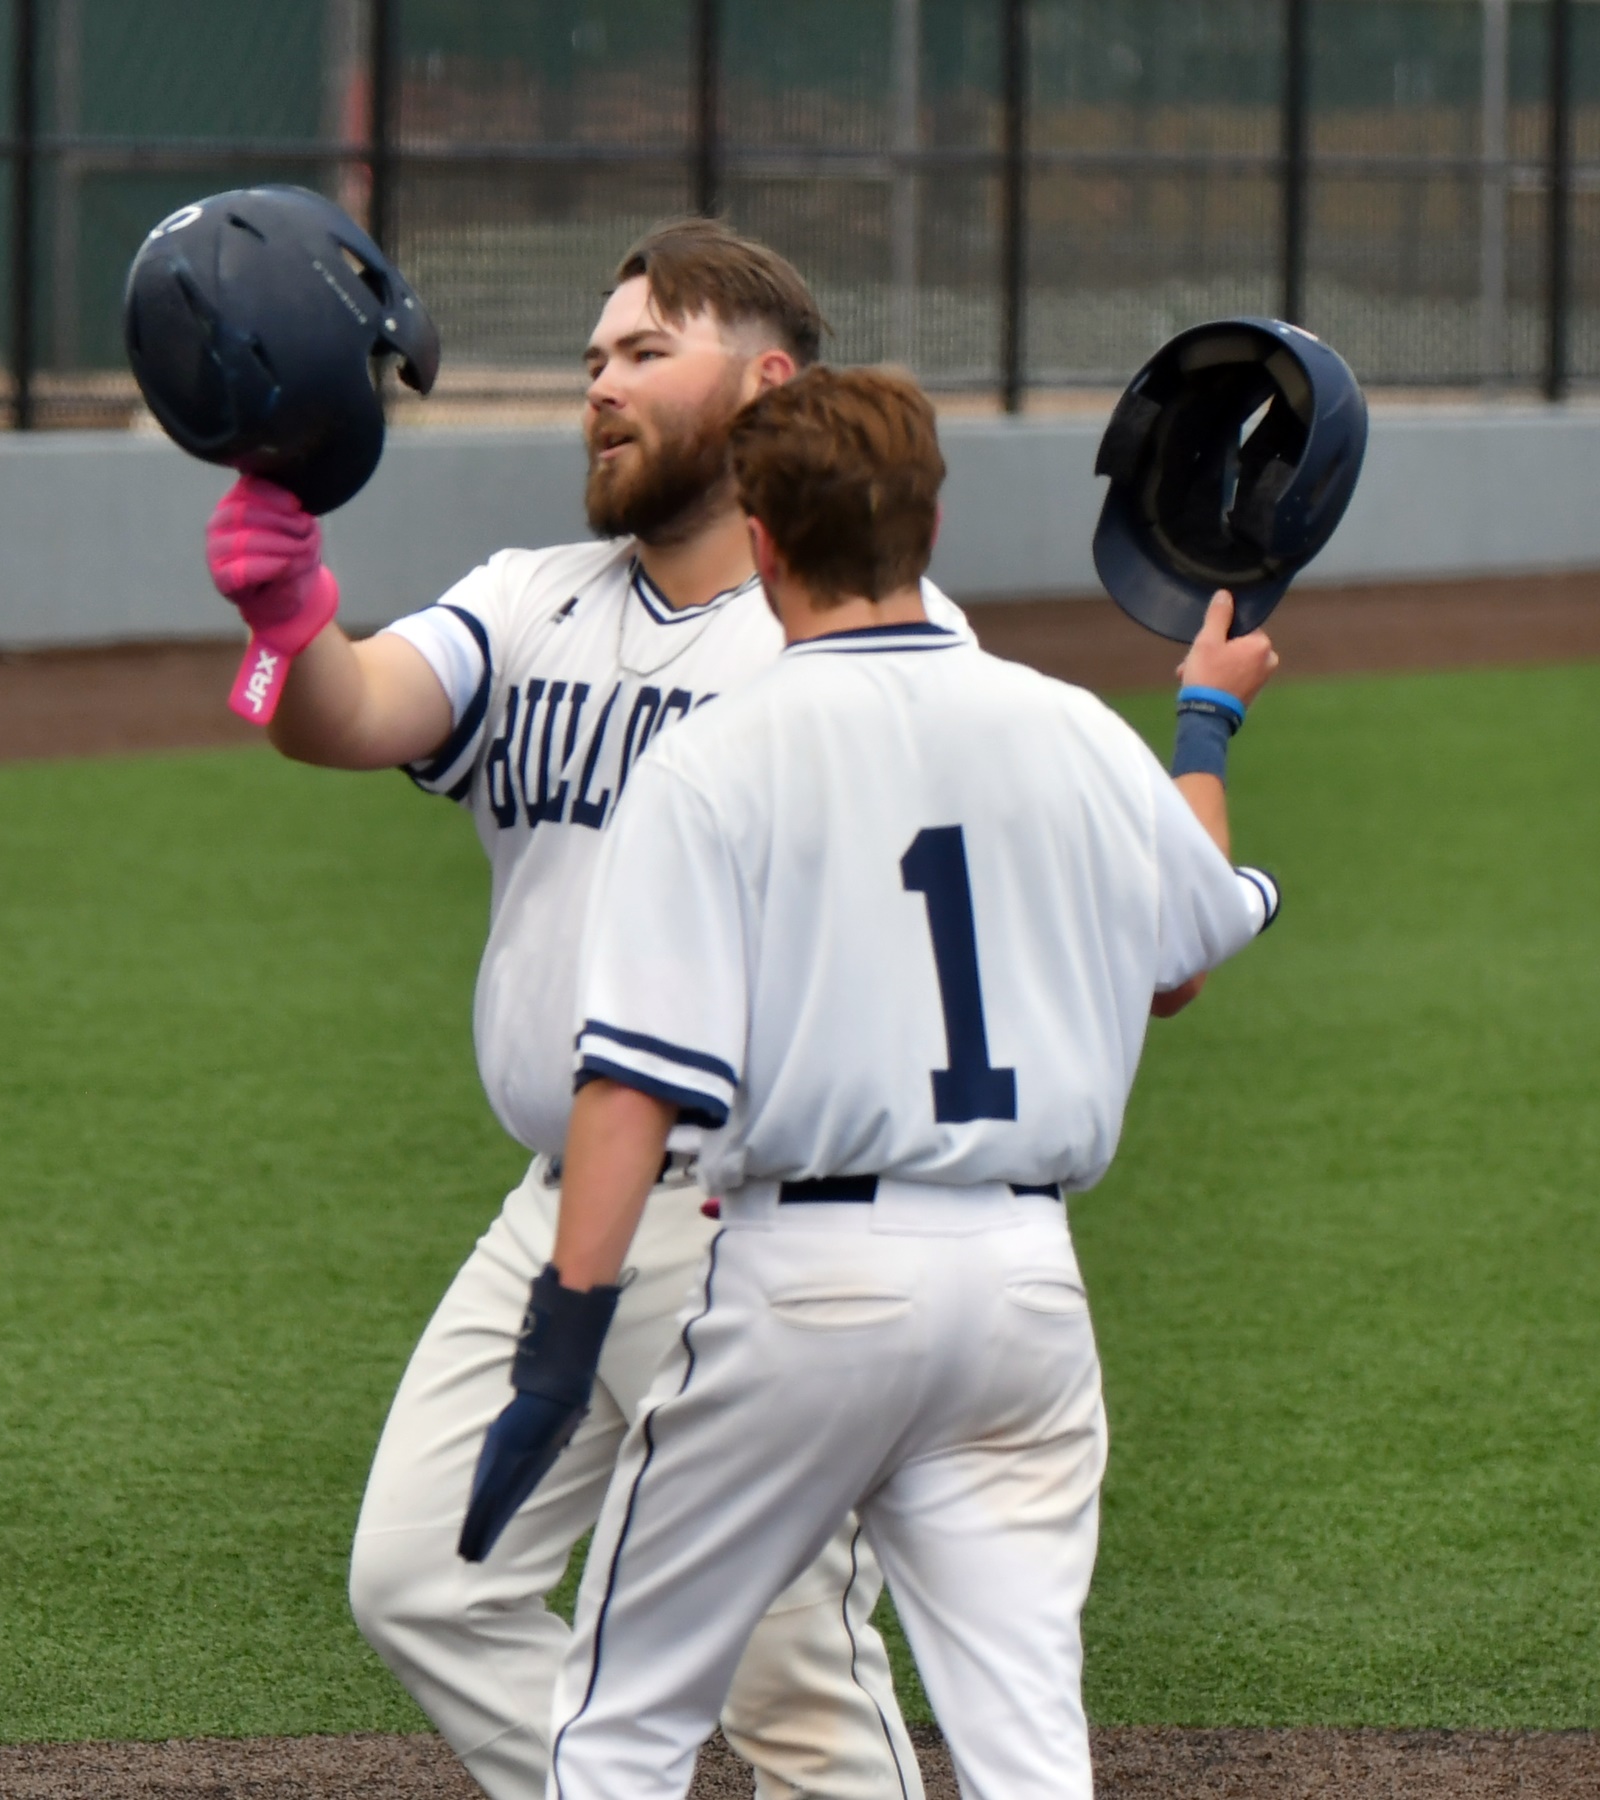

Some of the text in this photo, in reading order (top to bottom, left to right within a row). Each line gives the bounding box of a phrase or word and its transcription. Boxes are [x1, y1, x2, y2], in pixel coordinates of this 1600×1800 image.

[245, 649, 278, 714] JAX
[486, 678, 720, 831] BULLD
[899, 824, 1017, 1124] 1
